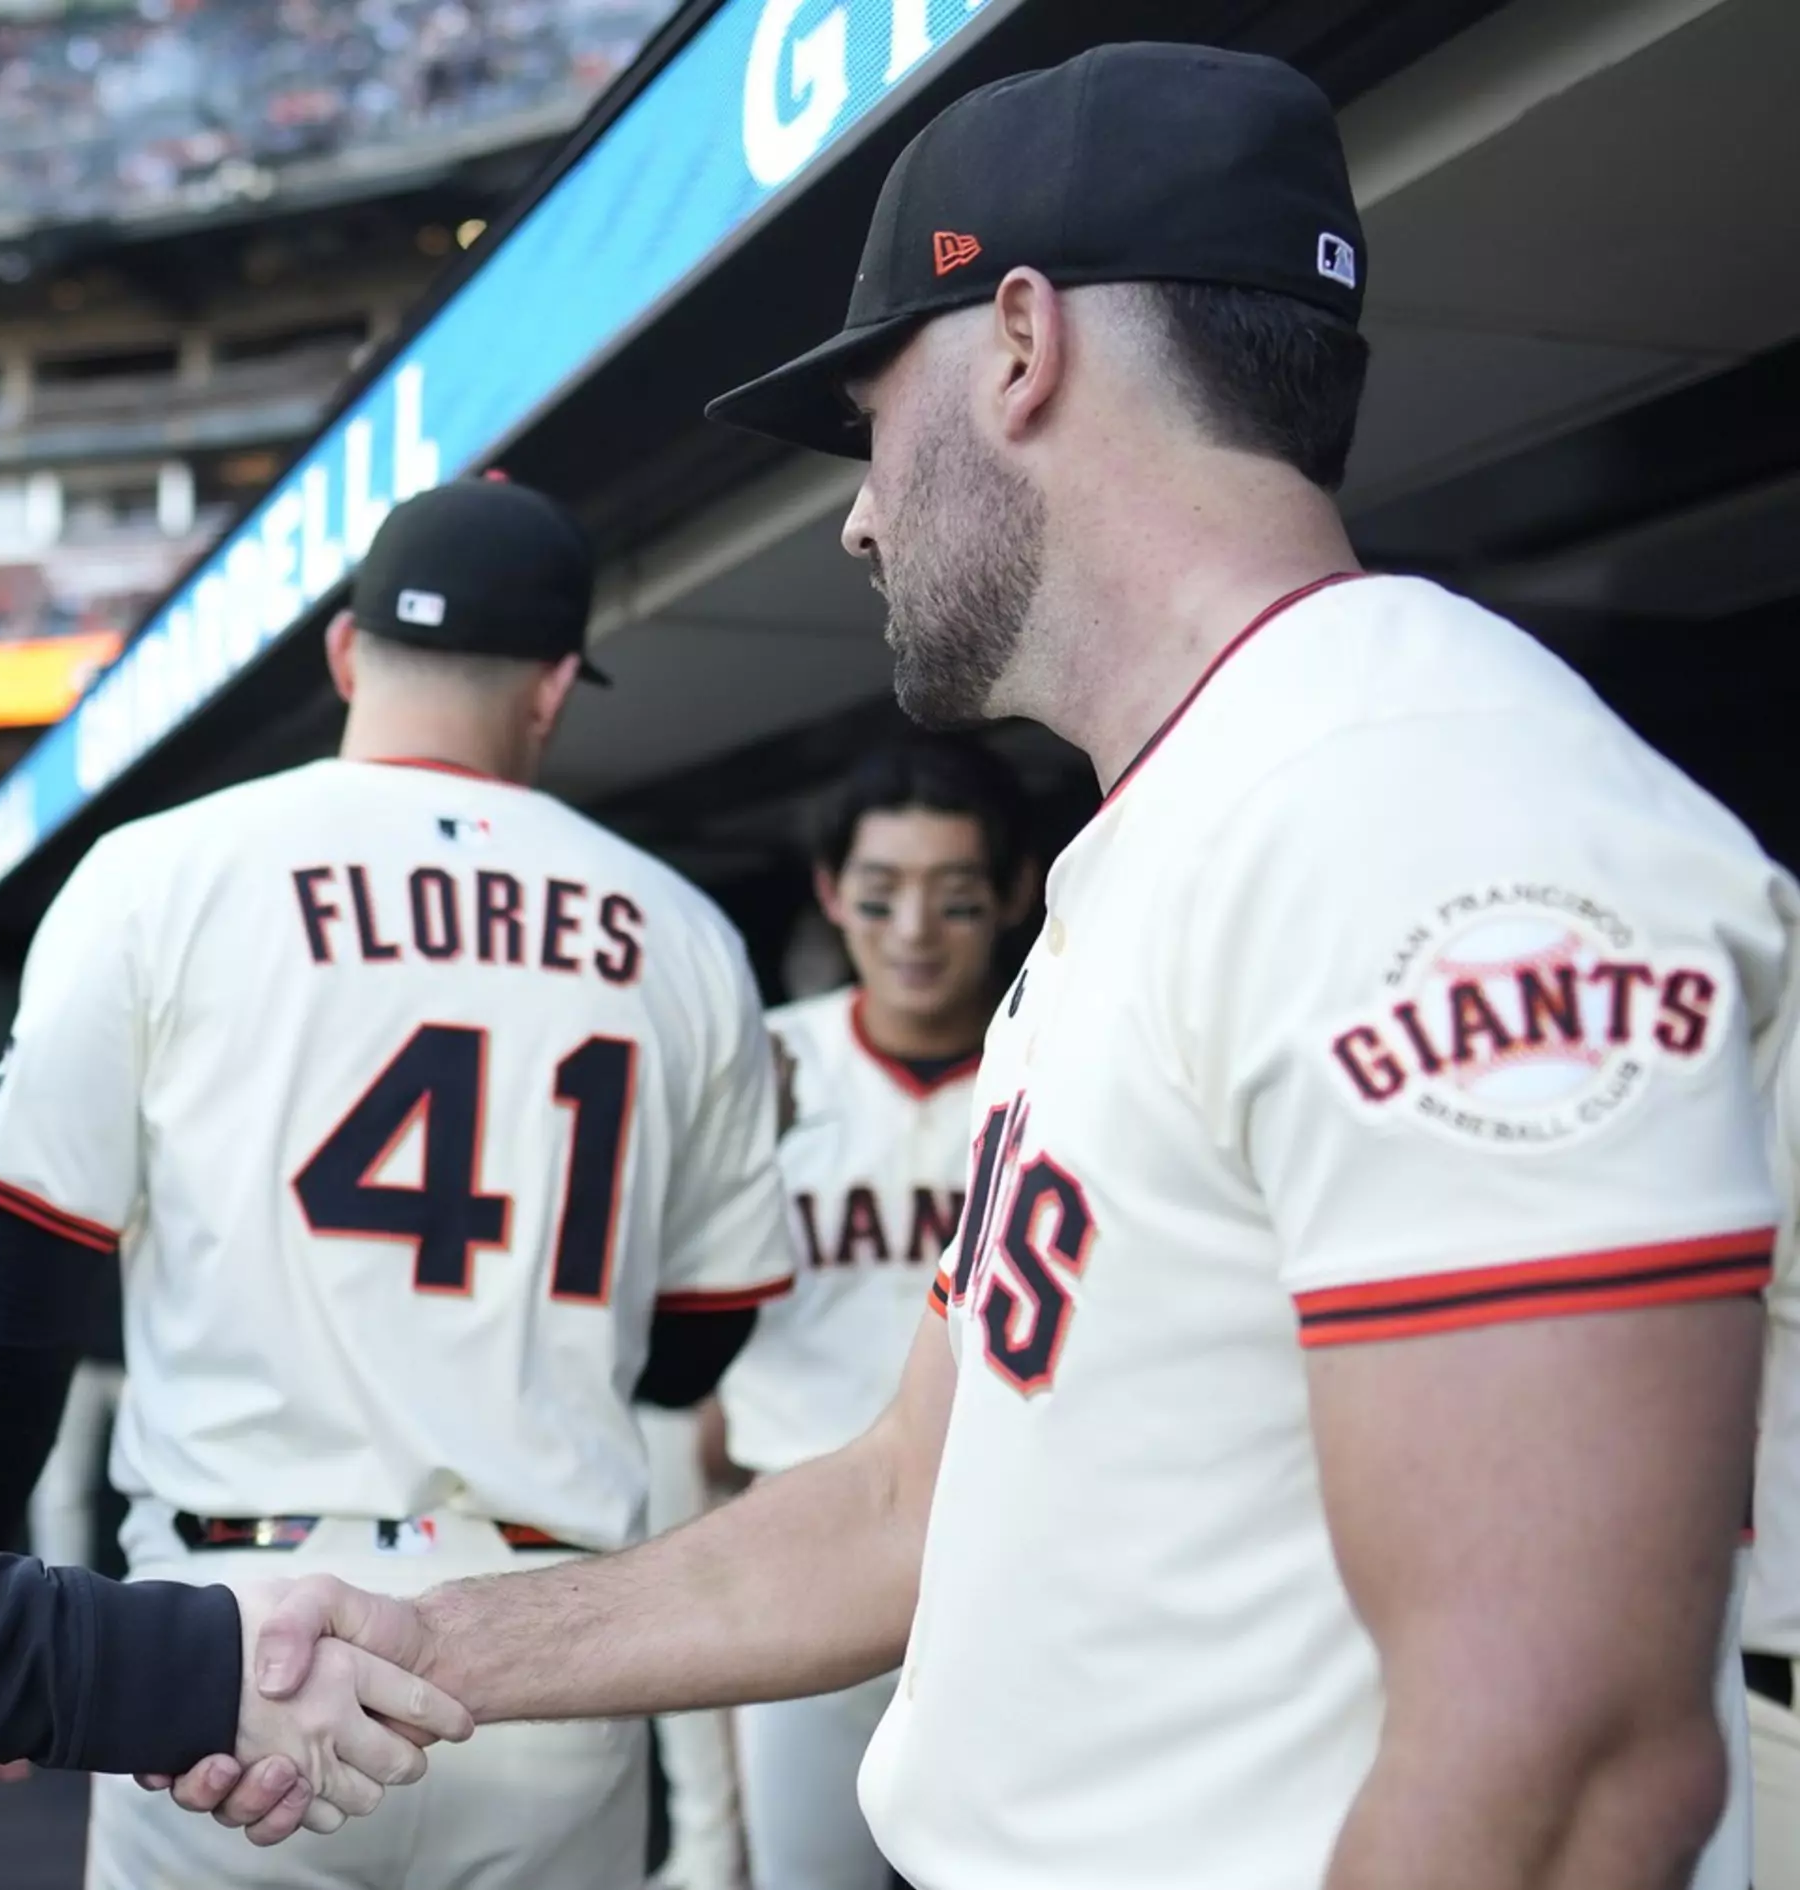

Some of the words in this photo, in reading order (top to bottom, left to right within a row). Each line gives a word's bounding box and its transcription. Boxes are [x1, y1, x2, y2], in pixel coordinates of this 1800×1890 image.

[291, 864, 645, 986] FLORES
[1384, 923, 1432, 985] SAN
[1437, 882, 1635, 950] FRANCISCO
[1331, 961, 1717, 1103] GIANTS
[1577, 1060, 1642, 1125] CLUB
[290, 1020, 640, 1307] 41
